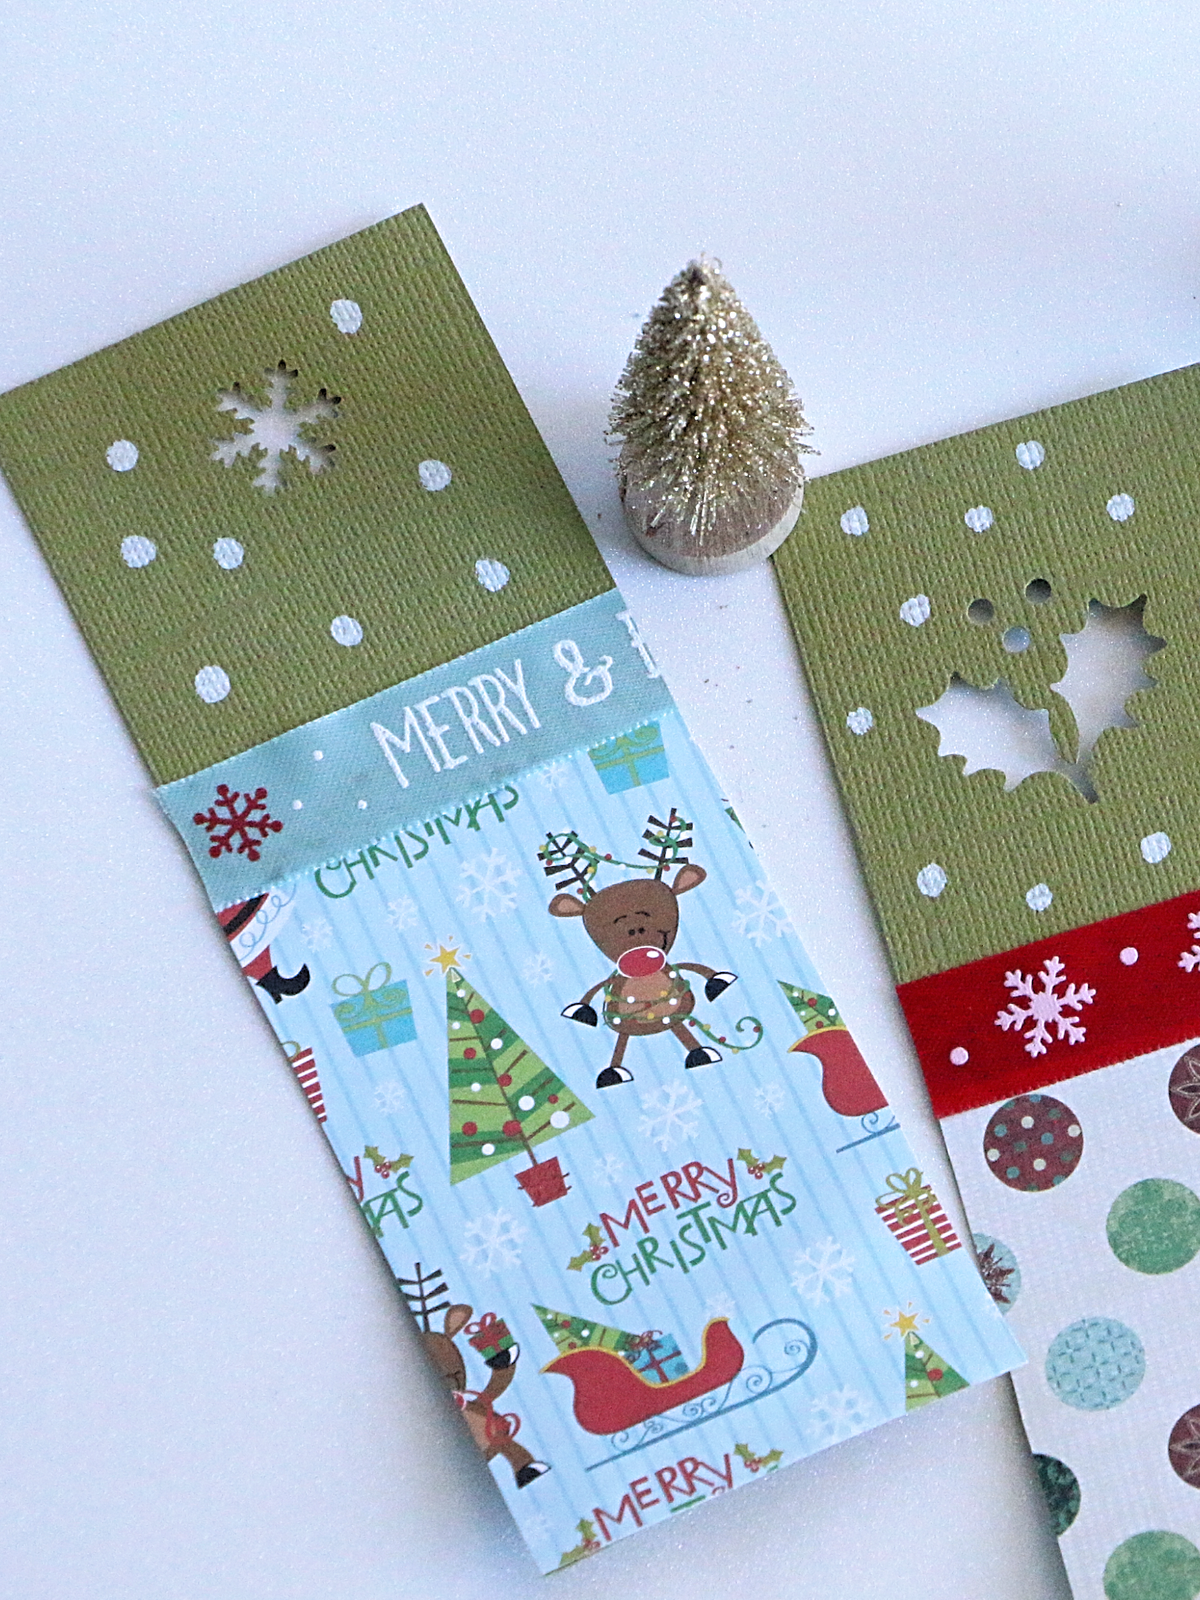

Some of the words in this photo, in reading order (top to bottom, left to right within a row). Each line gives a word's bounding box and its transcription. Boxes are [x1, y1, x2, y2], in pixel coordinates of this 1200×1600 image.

[369, 659, 542, 788] MERRY
[553, 638, 614, 707] &
[313, 784, 520, 899] CHISMAS
[589, 1171, 798, 1306] CHRISTMAS
[598, 1157, 739, 1249] MERRY
[591, 1452, 734, 1542] MERRY
